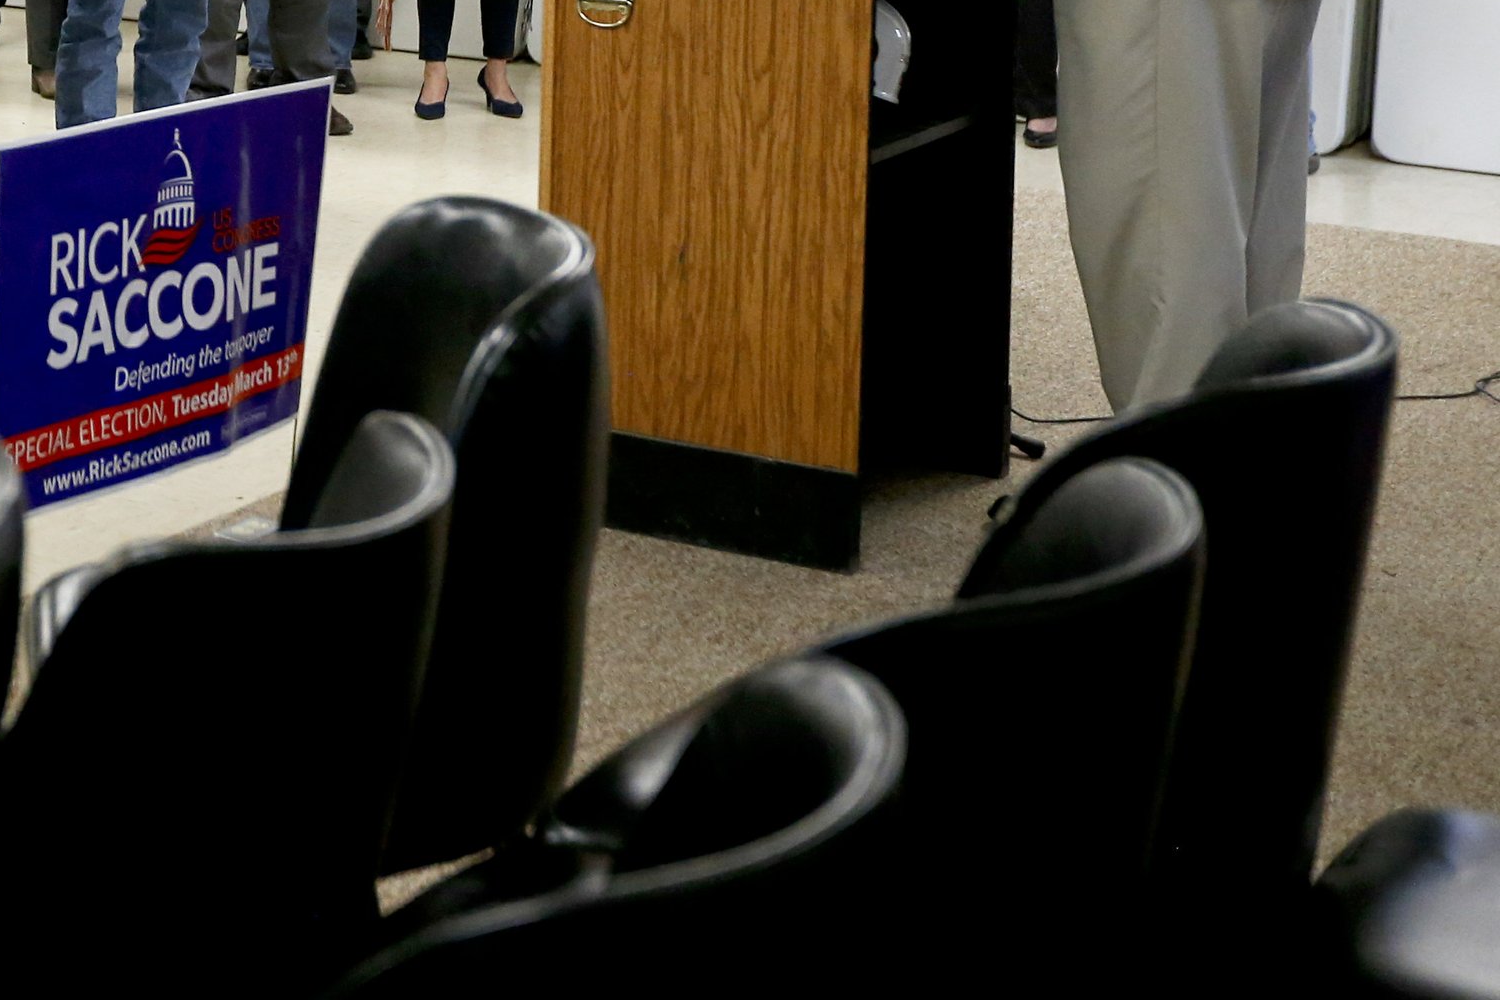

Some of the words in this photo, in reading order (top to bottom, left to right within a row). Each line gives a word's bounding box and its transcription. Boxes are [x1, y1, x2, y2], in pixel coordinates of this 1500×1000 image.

[50, 214, 147, 295] RICK
[213, 206, 232, 231] US
[46, 242, 279, 370] SACCONE
[114, 357, 195, 392] Defending
[199, 342, 222, 368] the
[224, 325, 275, 361] taxpayer
[5, 425, 74, 466] SPECIAL
[79, 399, 168, 446] ELECTION,
[172, 381, 234, 419] Tuesday
[233, 365, 272, 395] March
[276, 351, 299, 378] 13th
[43, 428, 211, 496] www.RickSaccone.com
